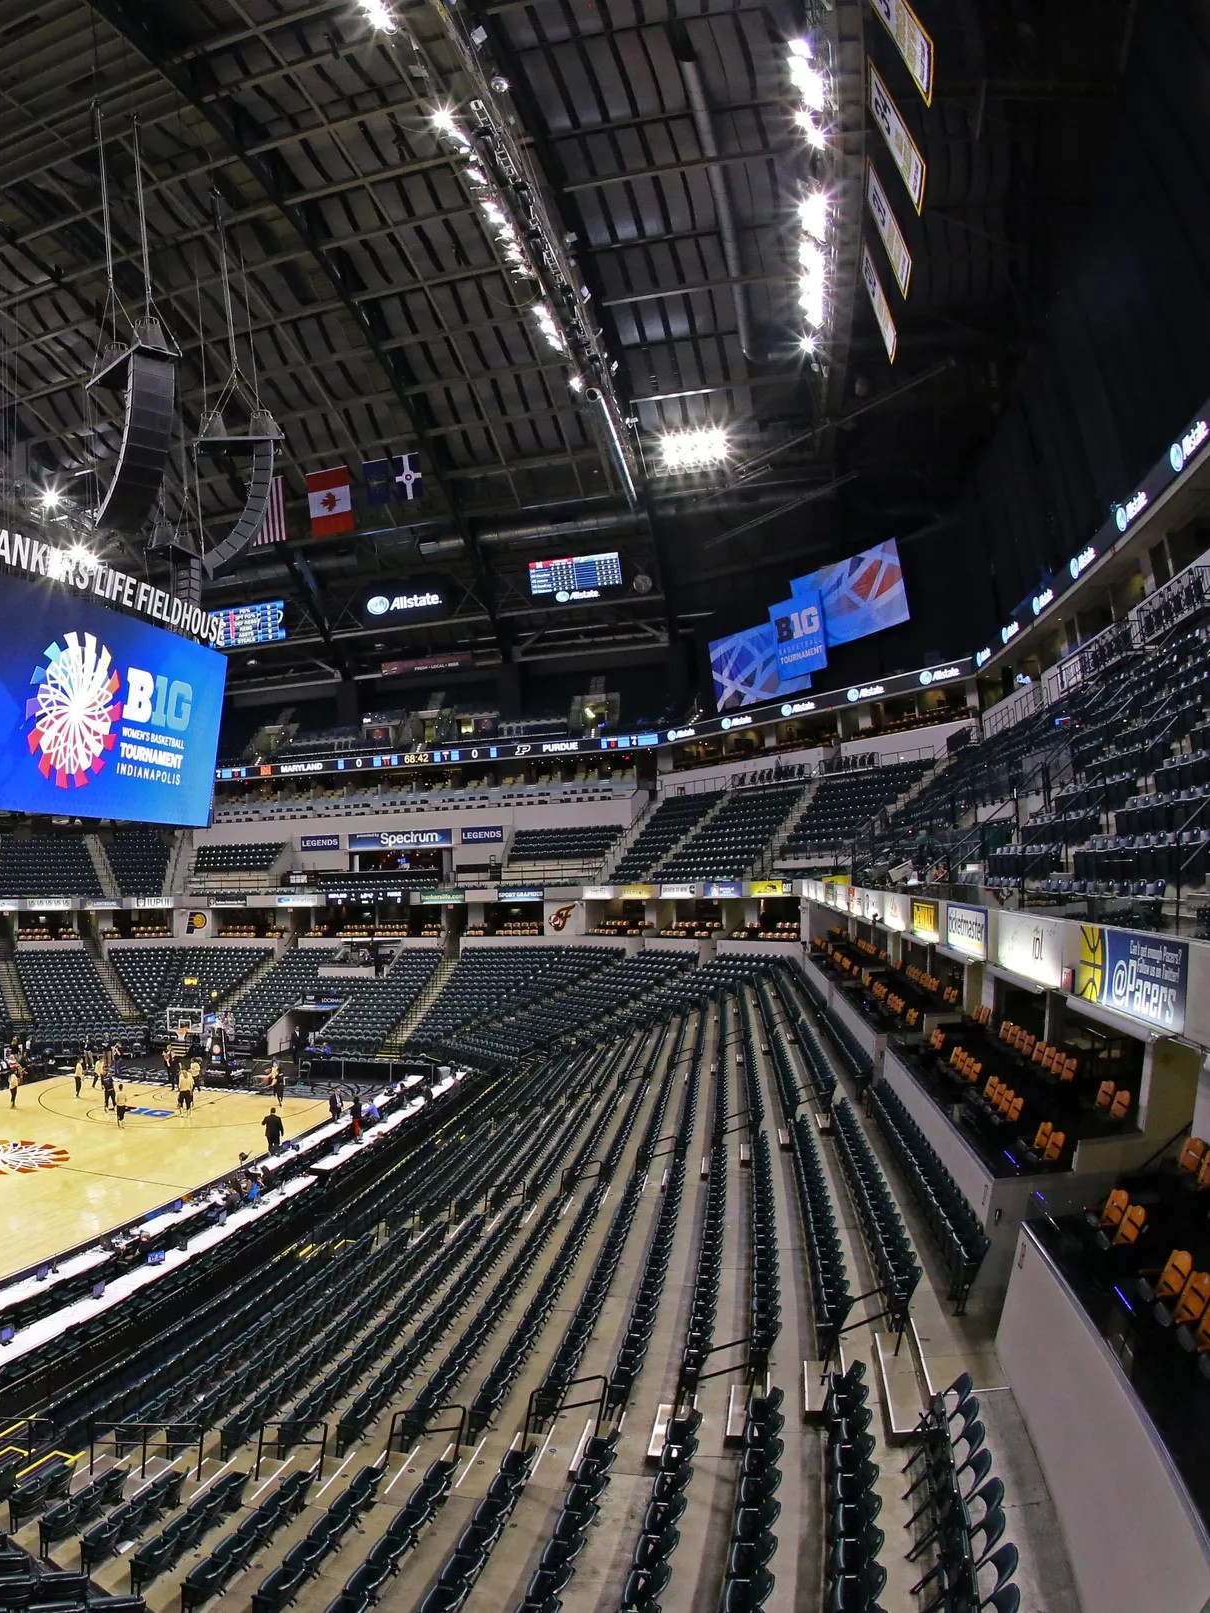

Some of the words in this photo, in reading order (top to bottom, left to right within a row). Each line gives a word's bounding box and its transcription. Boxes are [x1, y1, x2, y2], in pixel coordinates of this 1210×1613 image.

[94, 564, 137, 608] LIFE
[136, 581, 226, 646] FIELDHOUSE
[780, 645, 823, 665] TOURNAMENT
[122, 726, 150, 742] WOMEN'S
[150, 733, 185, 750] BASKETBALL
[120, 742, 183, 769] TOURNAMENT
[471, 749, 478, 758] 0
[542, 742, 578, 753] PURDUE
[356, 759, 362, 767] 0
[404, 753, 429, 763] 68:42
[116, 761, 181, 786] INDIANAPOLIS
[280, 763, 323, 773] MARYLAND
[302, 838, 338, 847] LEGENDS
[380, 831, 439, 847] Spectrum
[462, 831, 502, 840] LEGENDS
[147, 898, 169, 906] IUPUI
[948, 909, 984, 942] ticketmaster
[1163, 945, 1182, 965] Pacers?
[1112, 959, 1177, 1025] @Pacers
